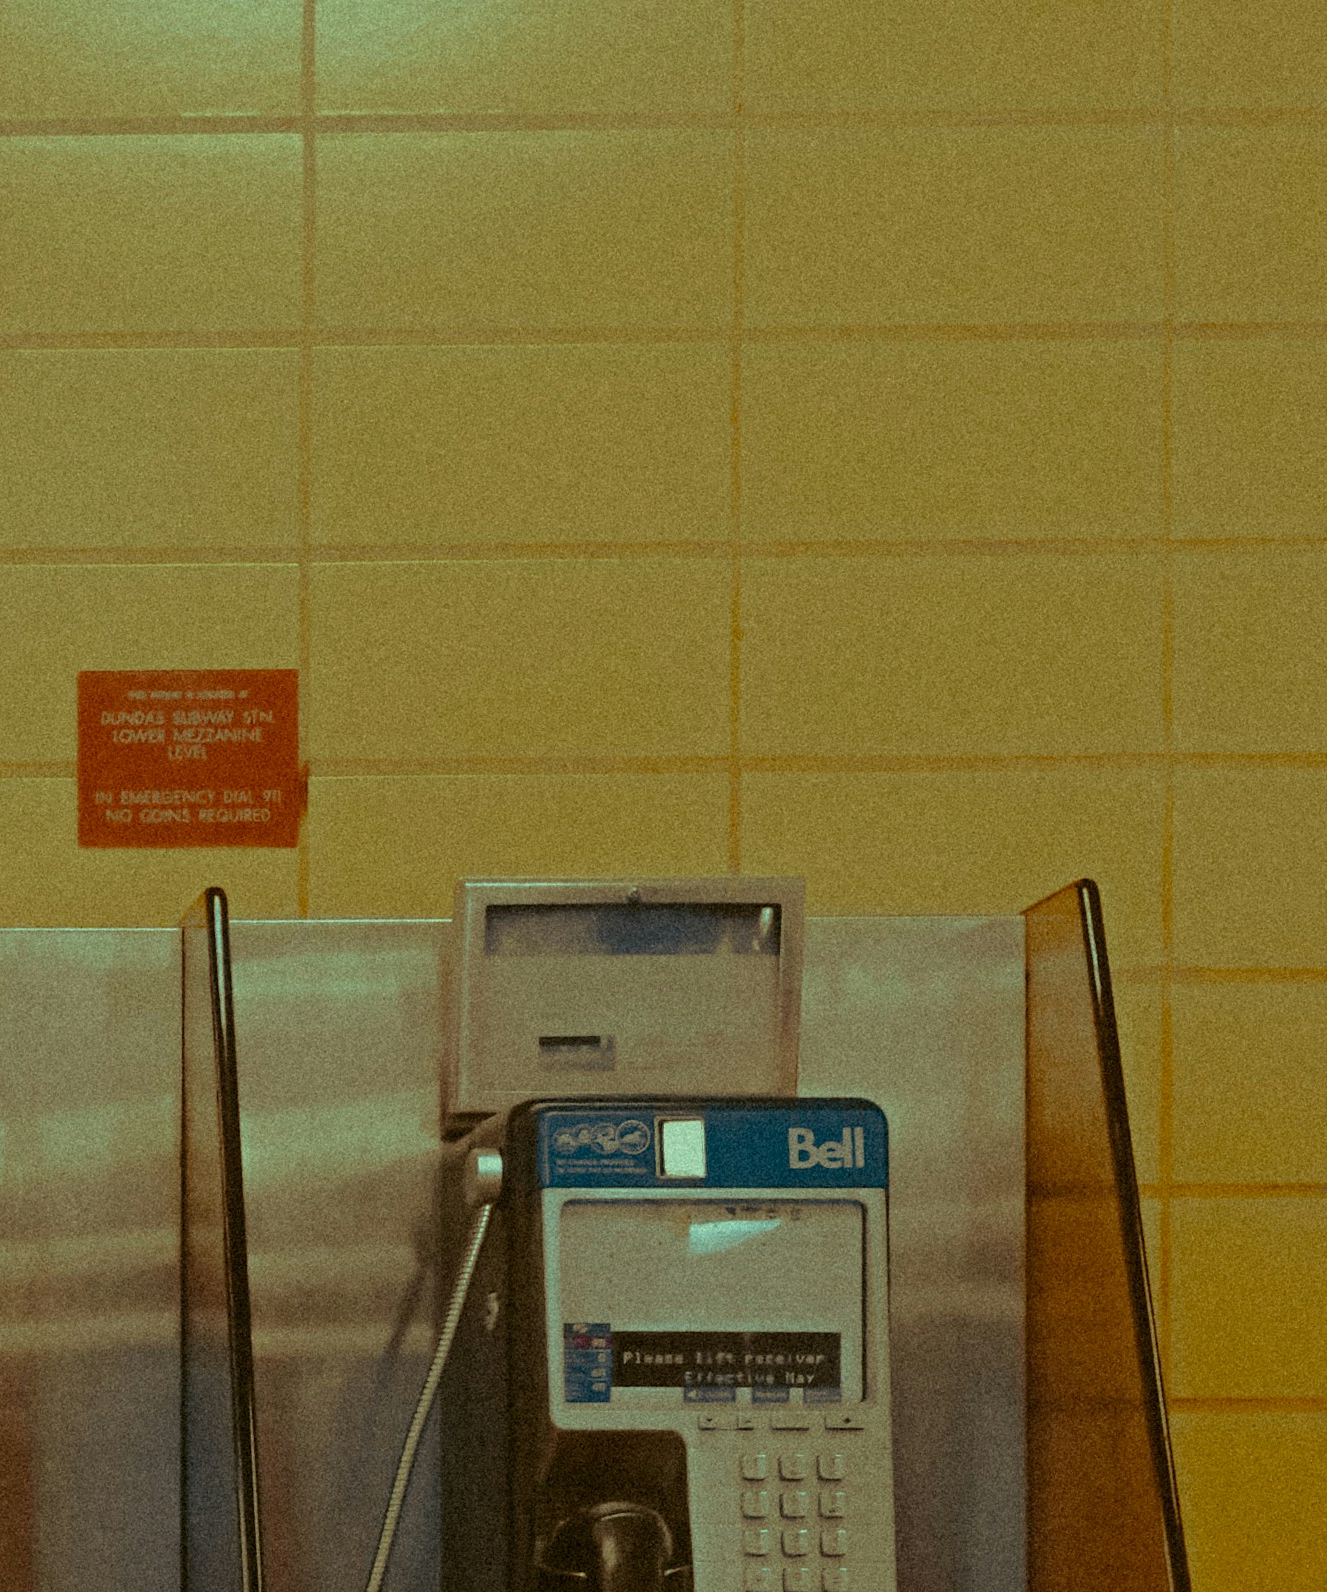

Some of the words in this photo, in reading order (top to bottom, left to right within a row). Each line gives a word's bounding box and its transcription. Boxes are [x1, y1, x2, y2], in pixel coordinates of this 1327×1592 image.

[101, 711, 165, 726] DUNDAS
[172, 709, 234, 724] SUBWAY
[112, 729, 166, 744] LOWER
[173, 728, 263, 743] MEZZANINE
[167, 745, 208, 761] LEVEL
[95, 791, 113, 804] IN
[120, 790, 214, 805] EMERGENCY
[223, 790, 254, 803] DIAL
[106, 809, 133, 824] NO
[140, 808, 190, 824] COINS
[199, 808, 272, 824] REQUIRED
[787, 1126, 865, 1169] Bell
[623, 1351, 684, 1365] Please
[695, 1351, 734, 1365] lift
[744, 1352, 825, 1365] receiver
[684, 1371, 774, 1384] Effective
[785, 1371, 814, 1385] May
